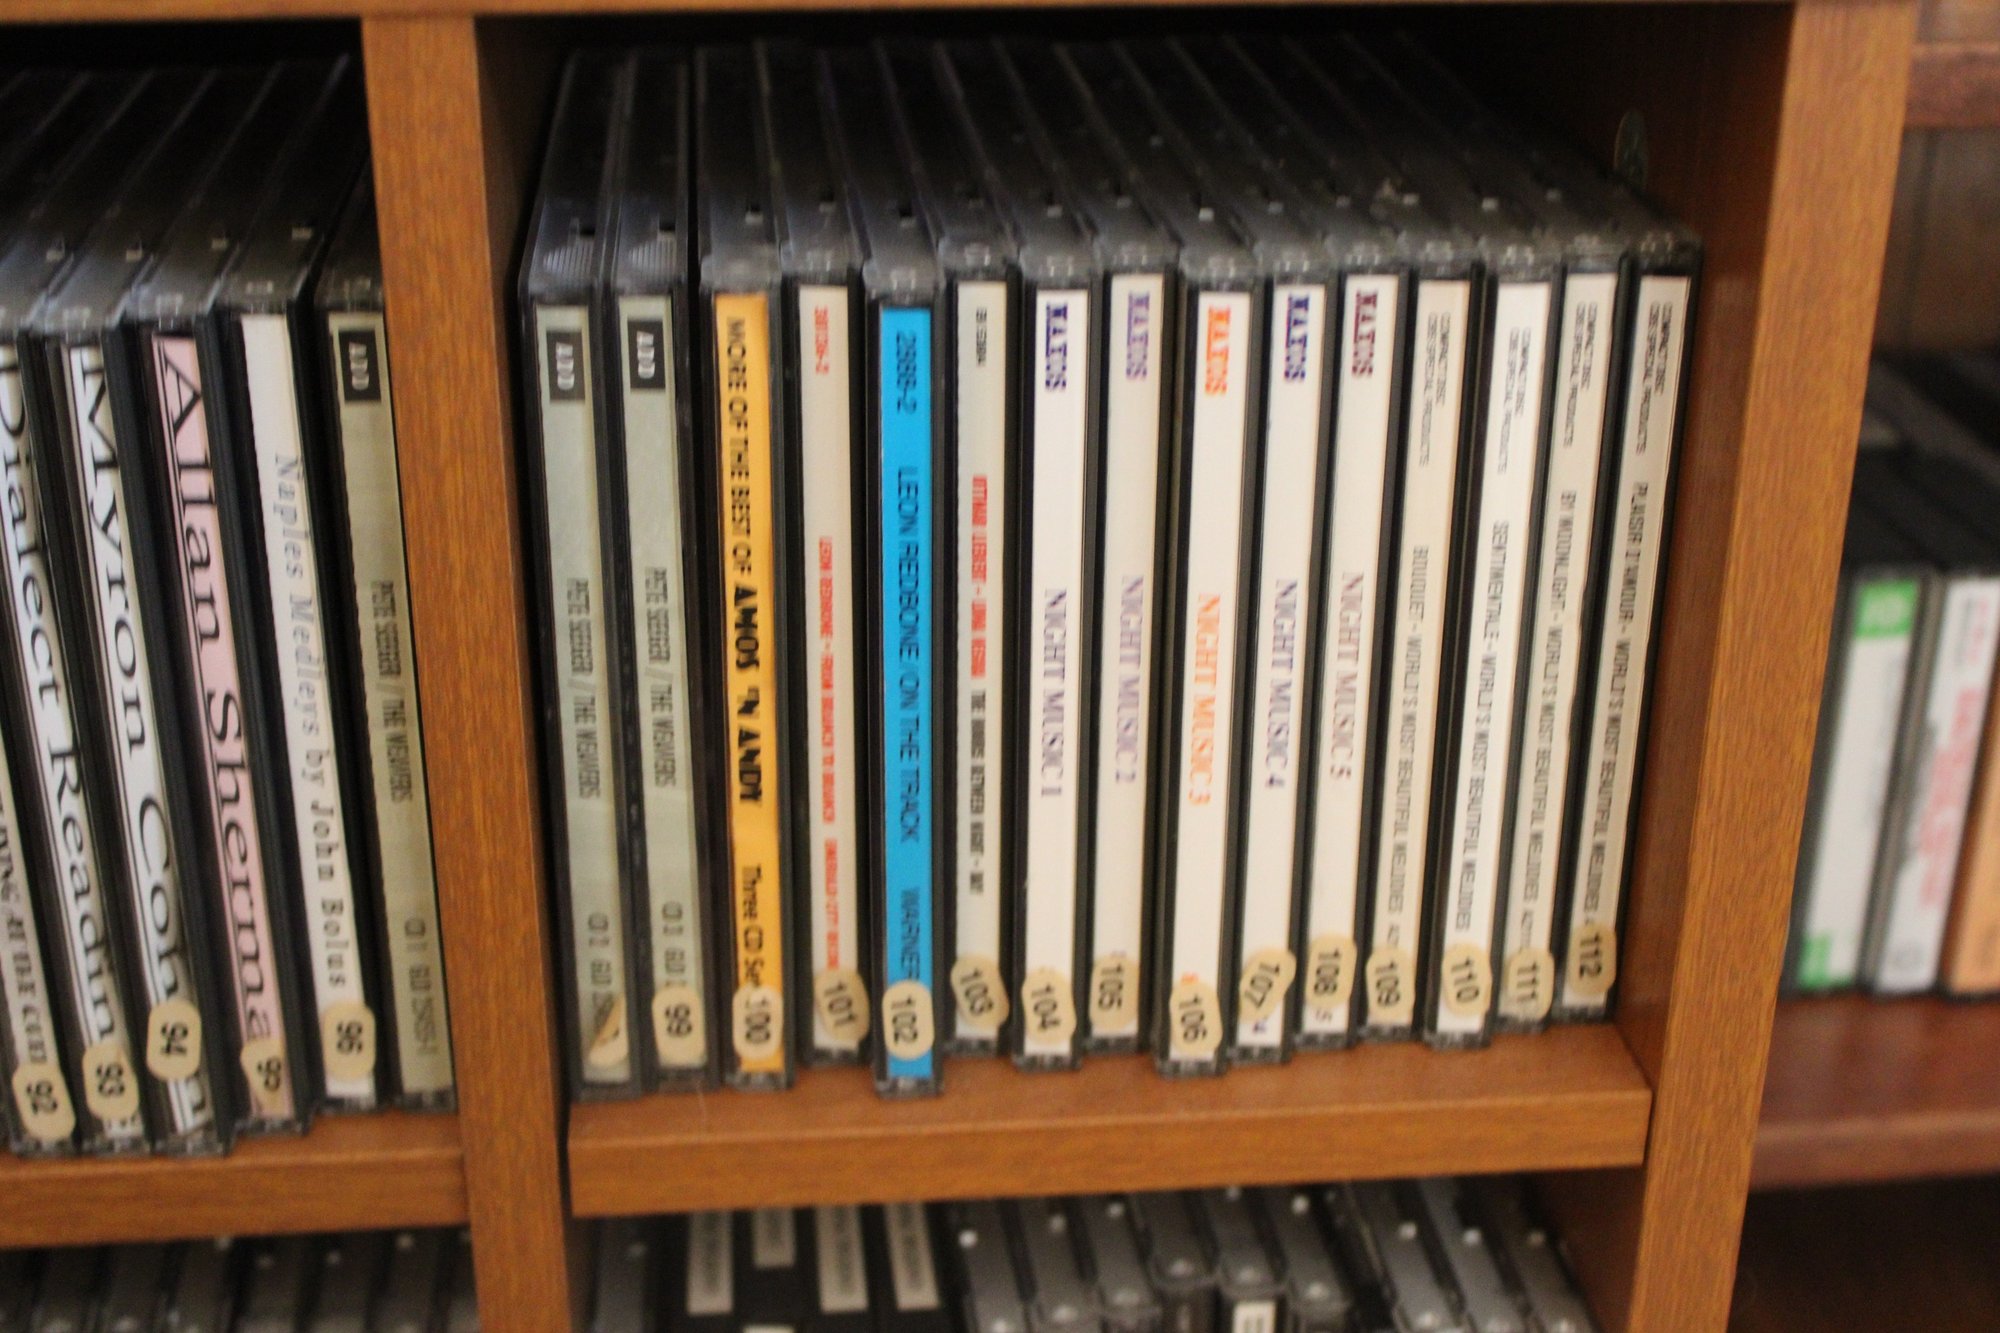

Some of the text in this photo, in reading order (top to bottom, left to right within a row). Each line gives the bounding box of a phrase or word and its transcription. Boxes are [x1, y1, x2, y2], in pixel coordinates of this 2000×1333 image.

[349, 341, 370, 391] ADD
[555, 341, 575, 391] ADD
[636, 331, 656, 378] ADD
[727, 317, 748, 392] MORE
[728, 399, 749, 432] OF
[728, 438, 751, 481] THE
[731, 486, 752, 537] BEST
[897, 465, 919, 535] LEON
[1560, 490, 1576, 511] BY
[1627, 481, 1649, 544] PLAISIR
[0, 363, 61, 710] Dialect
[732, 541, 753, 576] OF
[819, 535, 834, 571] LEON
[645, 567, 667, 604] PETE
[1408, 545, 1429, 623] BOUQUET
[1550, 515, 1574, 613] MOONLIGHT
[1618, 549, 1640, 626] D'AMOUR
[372, 579, 396, 619] PETE
[567, 578, 590, 615] PETE
[819, 575, 834, 640] REDBONE
[375, 619, 402, 677] SEEGER
[569, 616, 594, 676] SEEGER
[646, 606, 670, 664] SEEGER
[733, 582, 760, 673] AMOS
[820, 654, 835, 690] FROM
[1115, 576, 1144, 784] NIGHT MUSIC 2
[1264, 579, 1298, 788] NIGHT MUSIC 4
[1329, 572, 1365, 781] NIGHT MUSIC 5
[1402, 634, 1422, 710] WORLD'S
[1542, 624, 1563, 699] WORLD'S
[1609, 637, 1631, 711] WORLD'S
[163, 343, 271, 1040] Allan Sherma
[383, 698, 406, 728] THE
[574, 696, 598, 723] THE
[650, 684, 674, 719] THE
[1041, 588, 1067, 796] NIGHT MUSIC 1
[1188, 594, 1221, 805] NIGHT MUSIC 3
[80, 350, 211, 1121] Myron Cohn
[273, 451, 350, 989] Naples Medleys by John Bolus
[900, 717, 920, 761] THE
[1400, 711, 1417, 753] MOST
[1456, 520, 1509, 934] SENTIMENTALE WORLD'S MOST BEAUTIFUL MELODIES
[1538, 702, 1555, 744] MOST
[1603, 714, 1622, 757] MOST
[385, 729, 413, 803] WEAVERS
[577, 727, 601, 799] WEAVERS
[653, 719, 677, 788] WEAVERS
[737, 727, 763, 808] ANDY
[900, 767, 921, 845] TRACK
[1393, 756, 1414, 839] BEAUTIFUL
[1530, 748, 1552, 829] BEAUTIFUL
[1593, 759, 1617, 840] BEAUTIFUL
[741, 864, 763, 920] Three
[1388, 842, 1407, 914] MELODIES
[1523, 833, 1545, 903] MELODIES
[1584, 843, 1606, 915] MELODIES
[743, 923, 765, 953] CD
[1579, 931, 1603, 980] 112
[960, 967, 994, 1016] 103
[1098, 963, 1124, 1012] 105
[1244, 962, 1281, 1010] 107
[1313, 948, 1341, 997] 108
[1376, 960, 1401, 1008] 109
[1451, 957, 1480, 1003] 110
[1516, 960, 1540, 1009] 111
[665, 1003, 693, 1040] 99
[743, 992, 771, 1047] 100
[824, 983, 857, 1028] 101
[889, 997, 919, 1046] 102
[1031, 984, 1061, 1032] 104
[1179, 996, 1208, 1043] 106
[160, 1021, 189, 1057] 94
[336, 1020, 363, 1056] 96
[26, 1079, 58, 1115] 92
[96, 1062, 126, 1097] 93
[257, 1056, 282, 1092] 95
